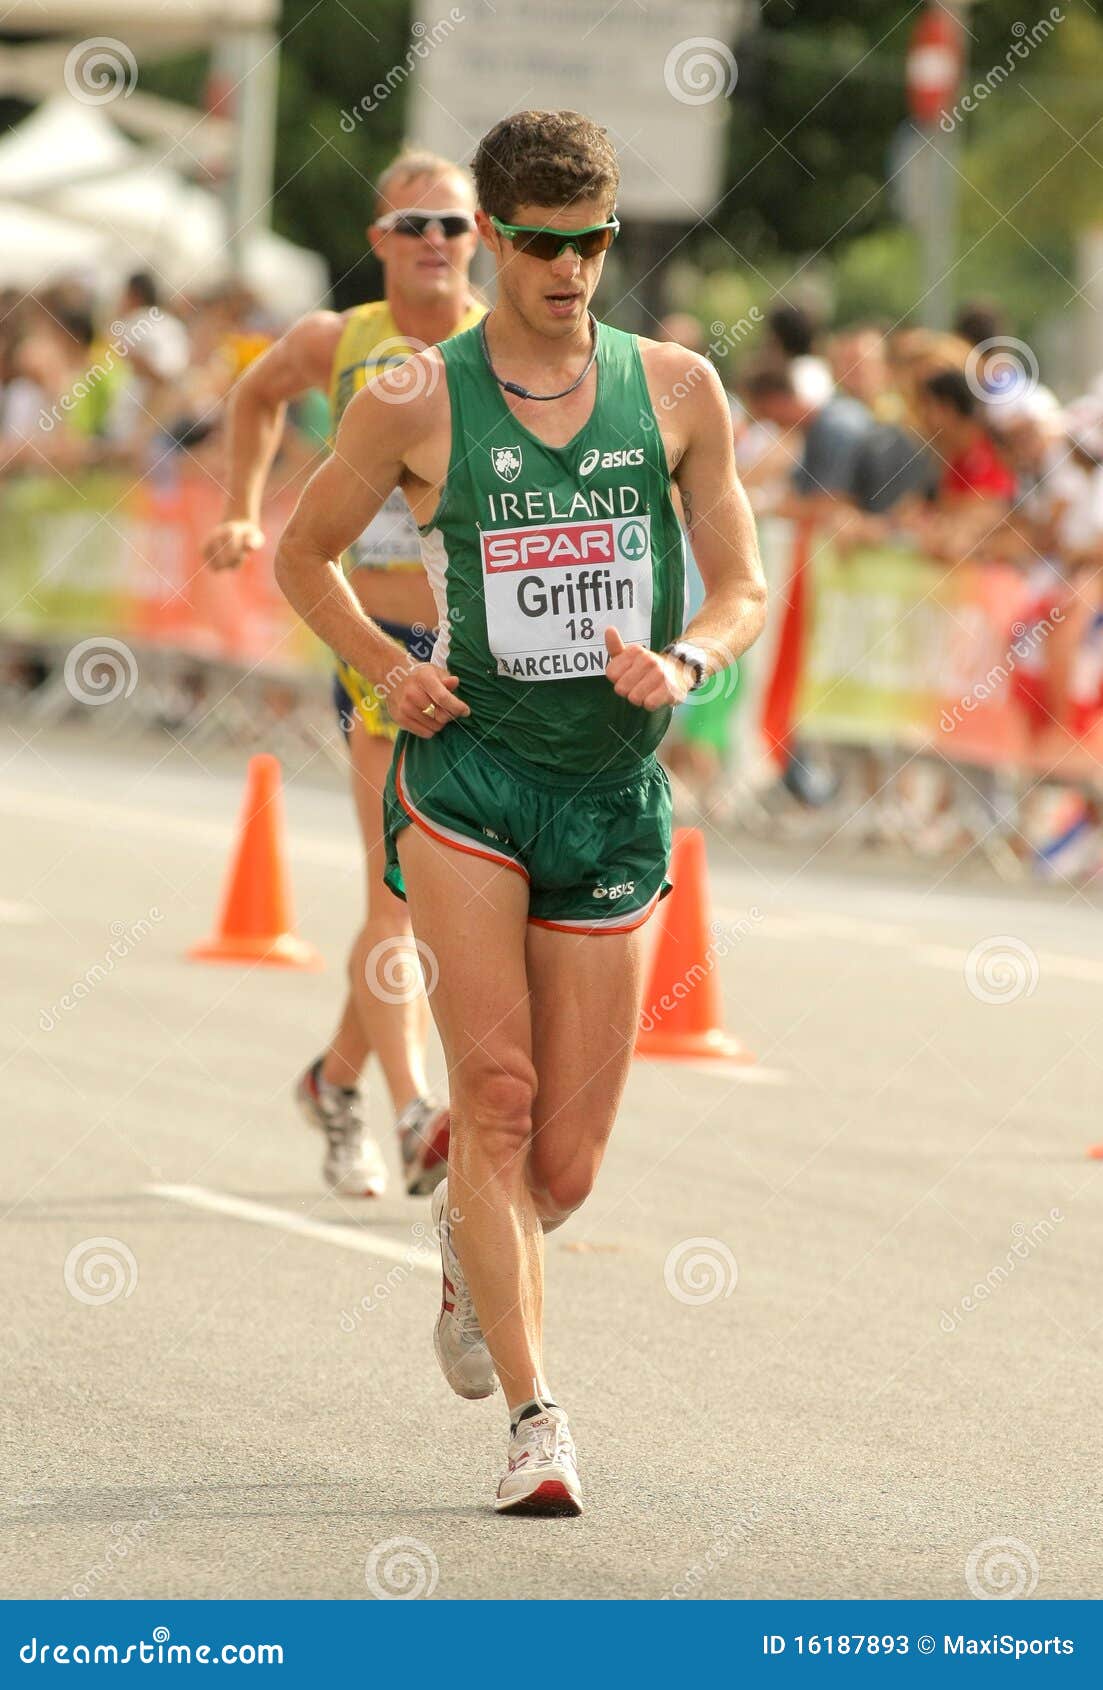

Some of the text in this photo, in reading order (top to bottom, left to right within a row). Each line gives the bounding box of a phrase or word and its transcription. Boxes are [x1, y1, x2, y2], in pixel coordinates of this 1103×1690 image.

[601, 448, 644, 469] asics
[488, 486, 640, 521] IRELAND
[488, 530, 611, 568] SPAR
[516, 569, 634, 618] Griffin
[565, 617, 595, 641] 18
[500, 651, 610, 677] BARCELON
